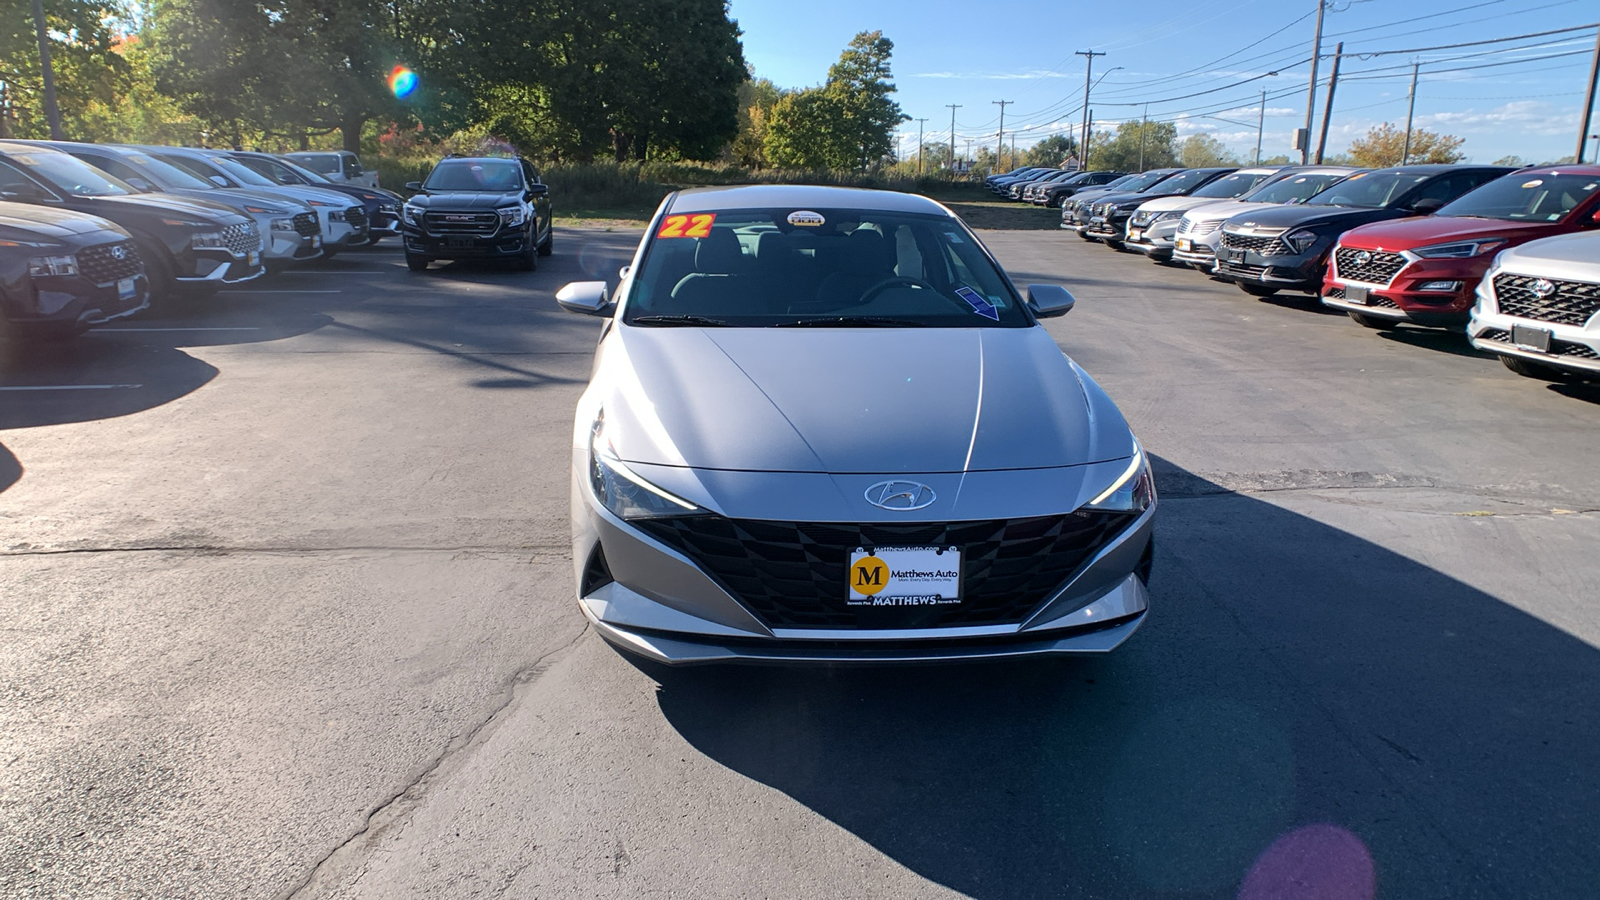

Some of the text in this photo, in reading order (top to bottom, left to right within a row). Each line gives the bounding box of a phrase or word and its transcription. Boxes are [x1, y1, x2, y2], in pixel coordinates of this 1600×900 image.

[660, 215, 712, 237] 22
[855, 566, 883, 586] M
[890, 569, 958, 578] Matthews Auto
[872, 595, 937, 606] MATTHEWS
